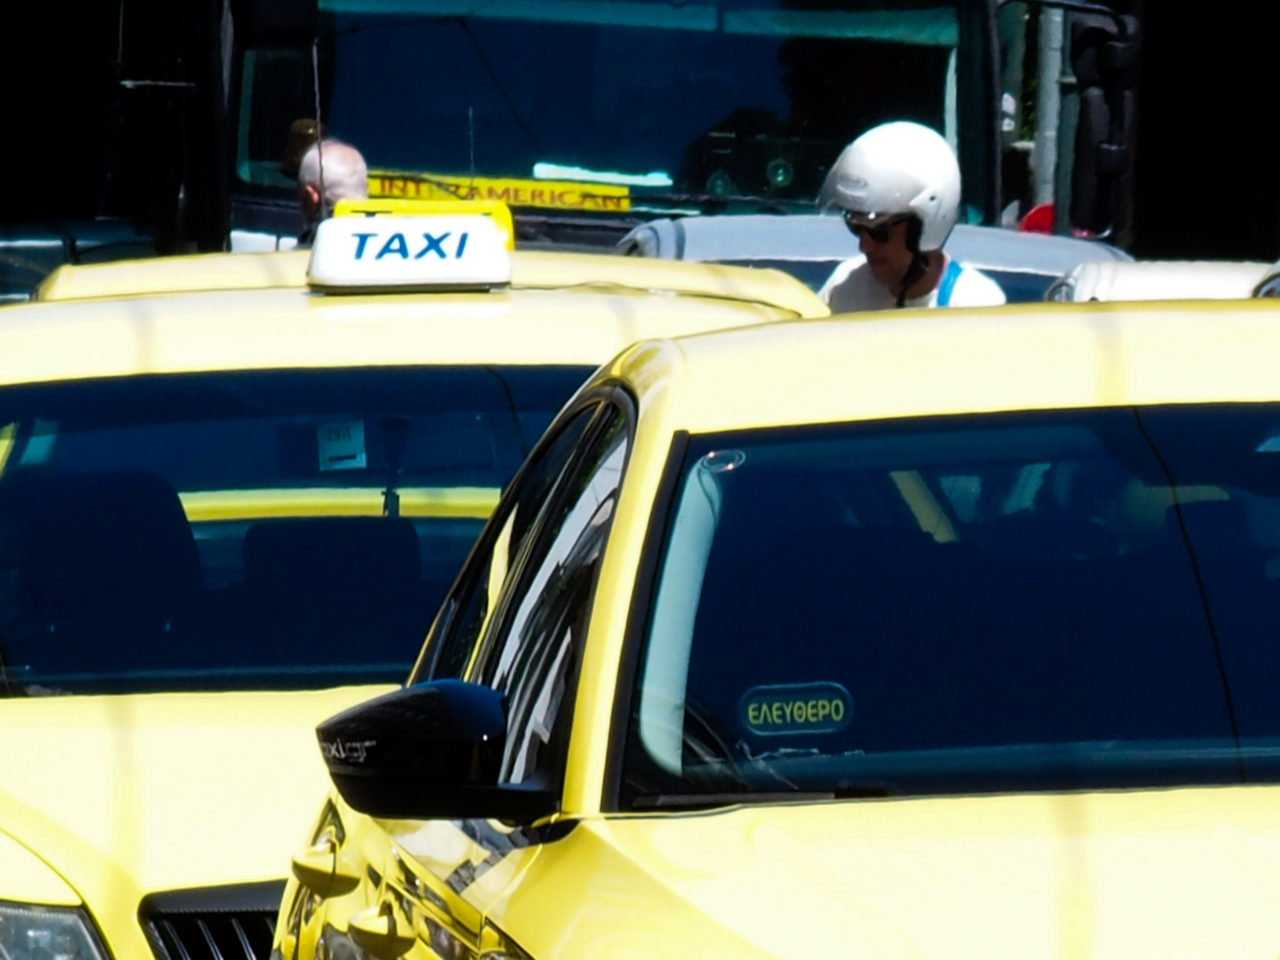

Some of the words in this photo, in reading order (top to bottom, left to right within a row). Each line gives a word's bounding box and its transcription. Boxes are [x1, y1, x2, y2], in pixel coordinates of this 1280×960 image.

[379, 177, 622, 209] INTAMERICAN
[351, 232, 469, 260] TAXI
[748, 699, 844, 724] ΕΛΕΥΘΕΡΟ
